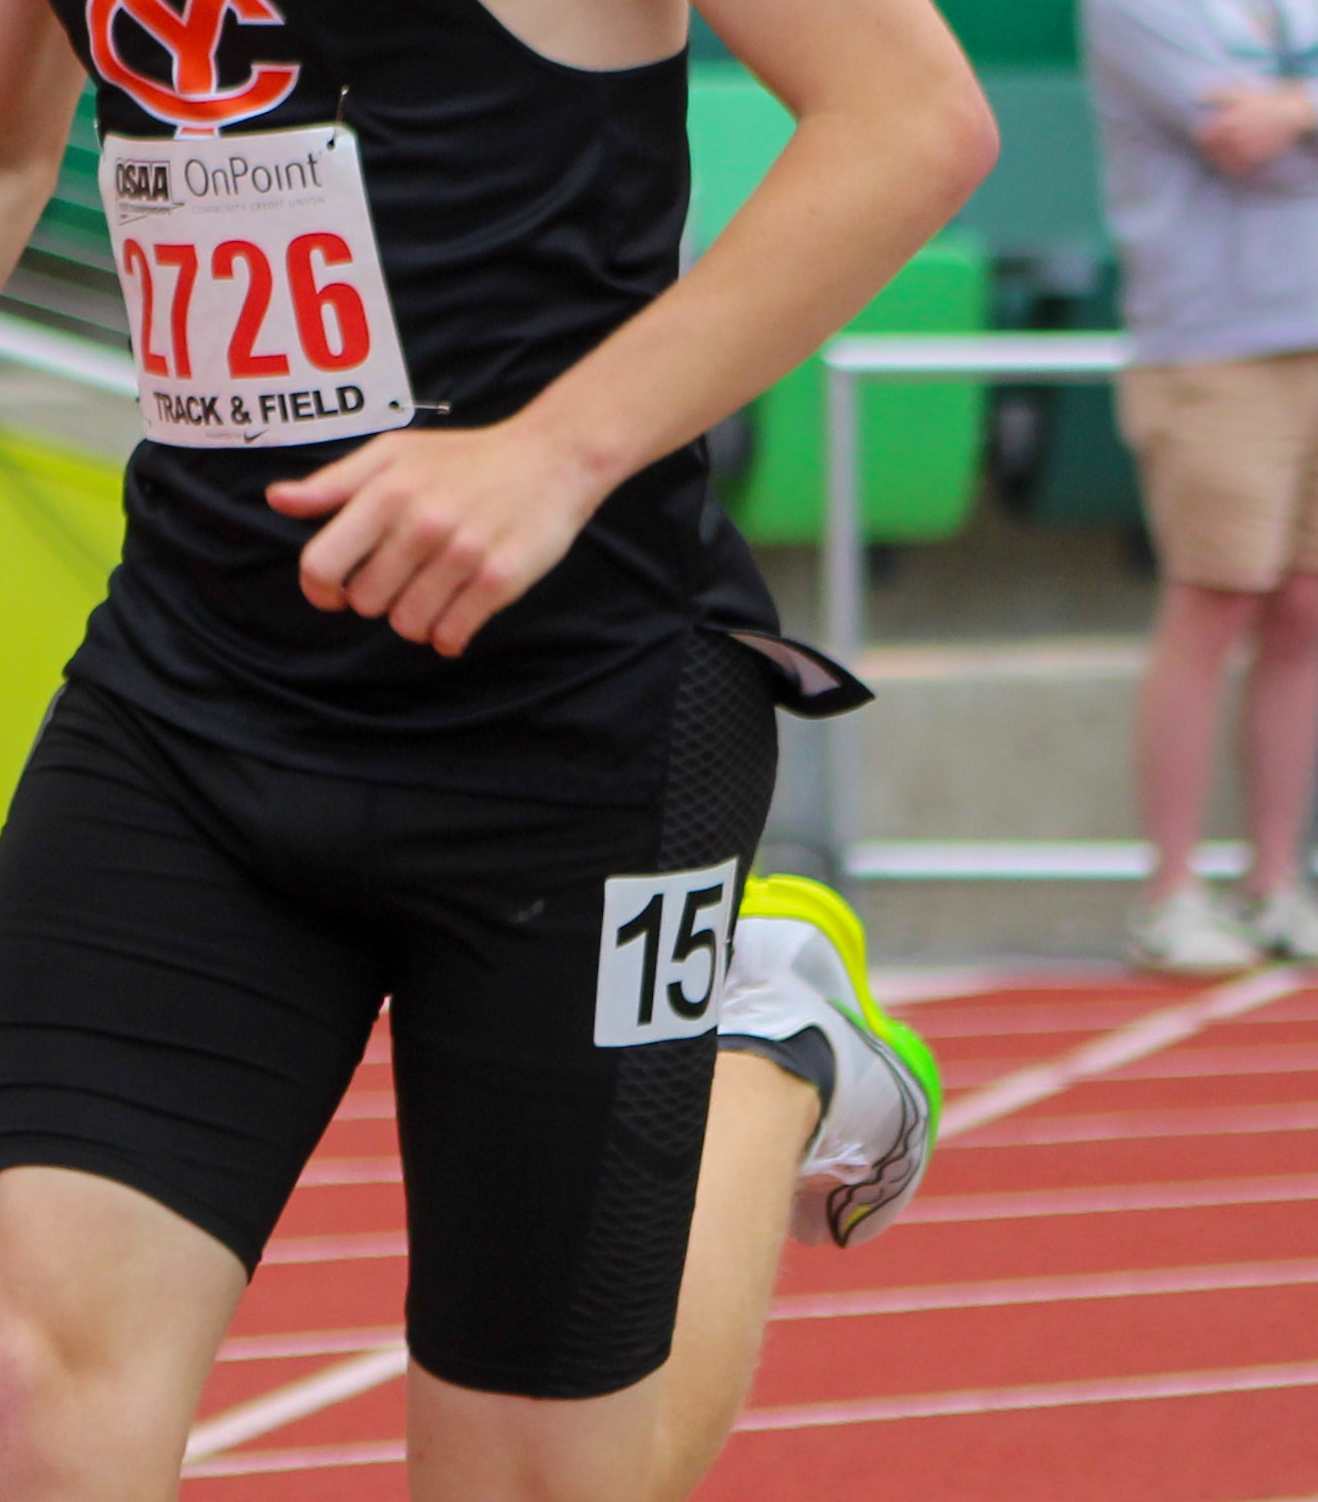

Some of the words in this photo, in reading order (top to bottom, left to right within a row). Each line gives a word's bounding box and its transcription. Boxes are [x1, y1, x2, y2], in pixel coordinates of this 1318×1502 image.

[116, 159, 170, 201] OSAA
[184, 153, 323, 198] OnPoint
[123, 232, 371, 380] 2726
[153, 390, 222, 426] TRACK
[230, 397, 252, 426] &
[259, 385, 365, 424] FIELD
[615, 883, 724, 1027] 15
